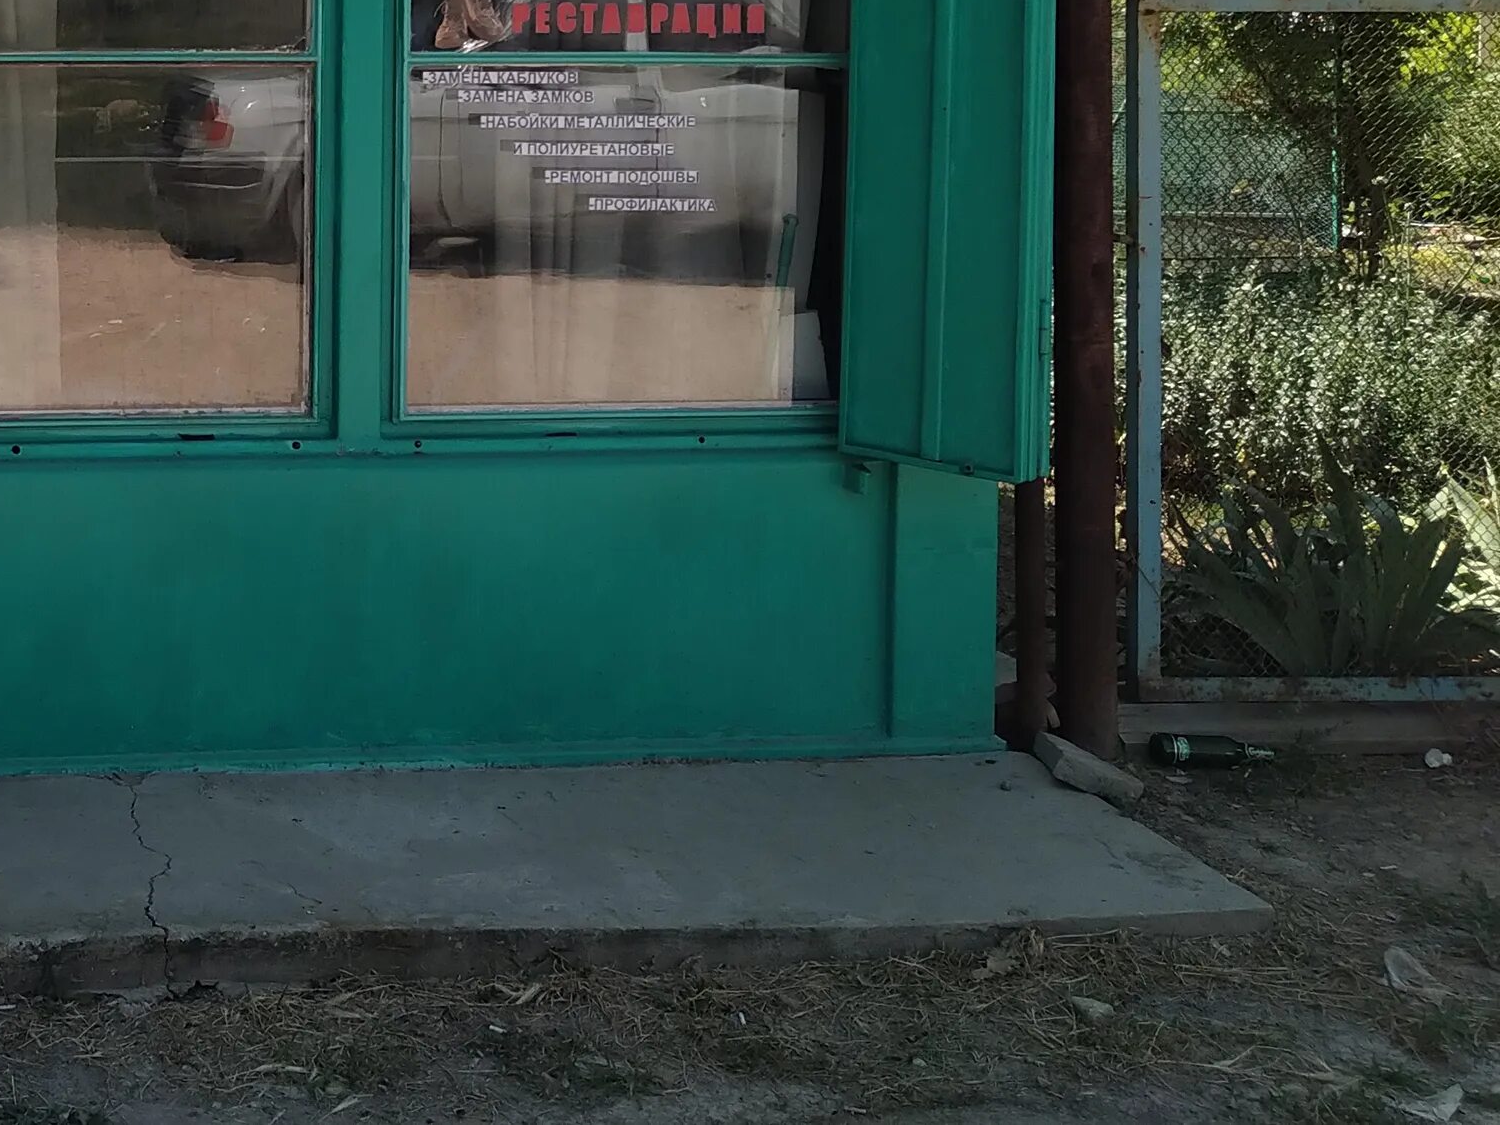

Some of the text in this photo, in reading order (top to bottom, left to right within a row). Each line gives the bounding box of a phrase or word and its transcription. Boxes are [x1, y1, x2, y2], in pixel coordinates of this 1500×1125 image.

[511, 1, 766, 38] РЕСТАВРАЦИЯ
[498, 71, 578, 85] КАБЛУКОВ
[530, 90, 595, 103] ЗАМКОВ
[564, 115, 696, 128] МЕТАЛЛИЧЕСКИЕ
[513, 142, 675, 156] И ПОЛИУРЕТАНОВЫЕ
[617, 170, 699, 185] ПОДОШВЫ
